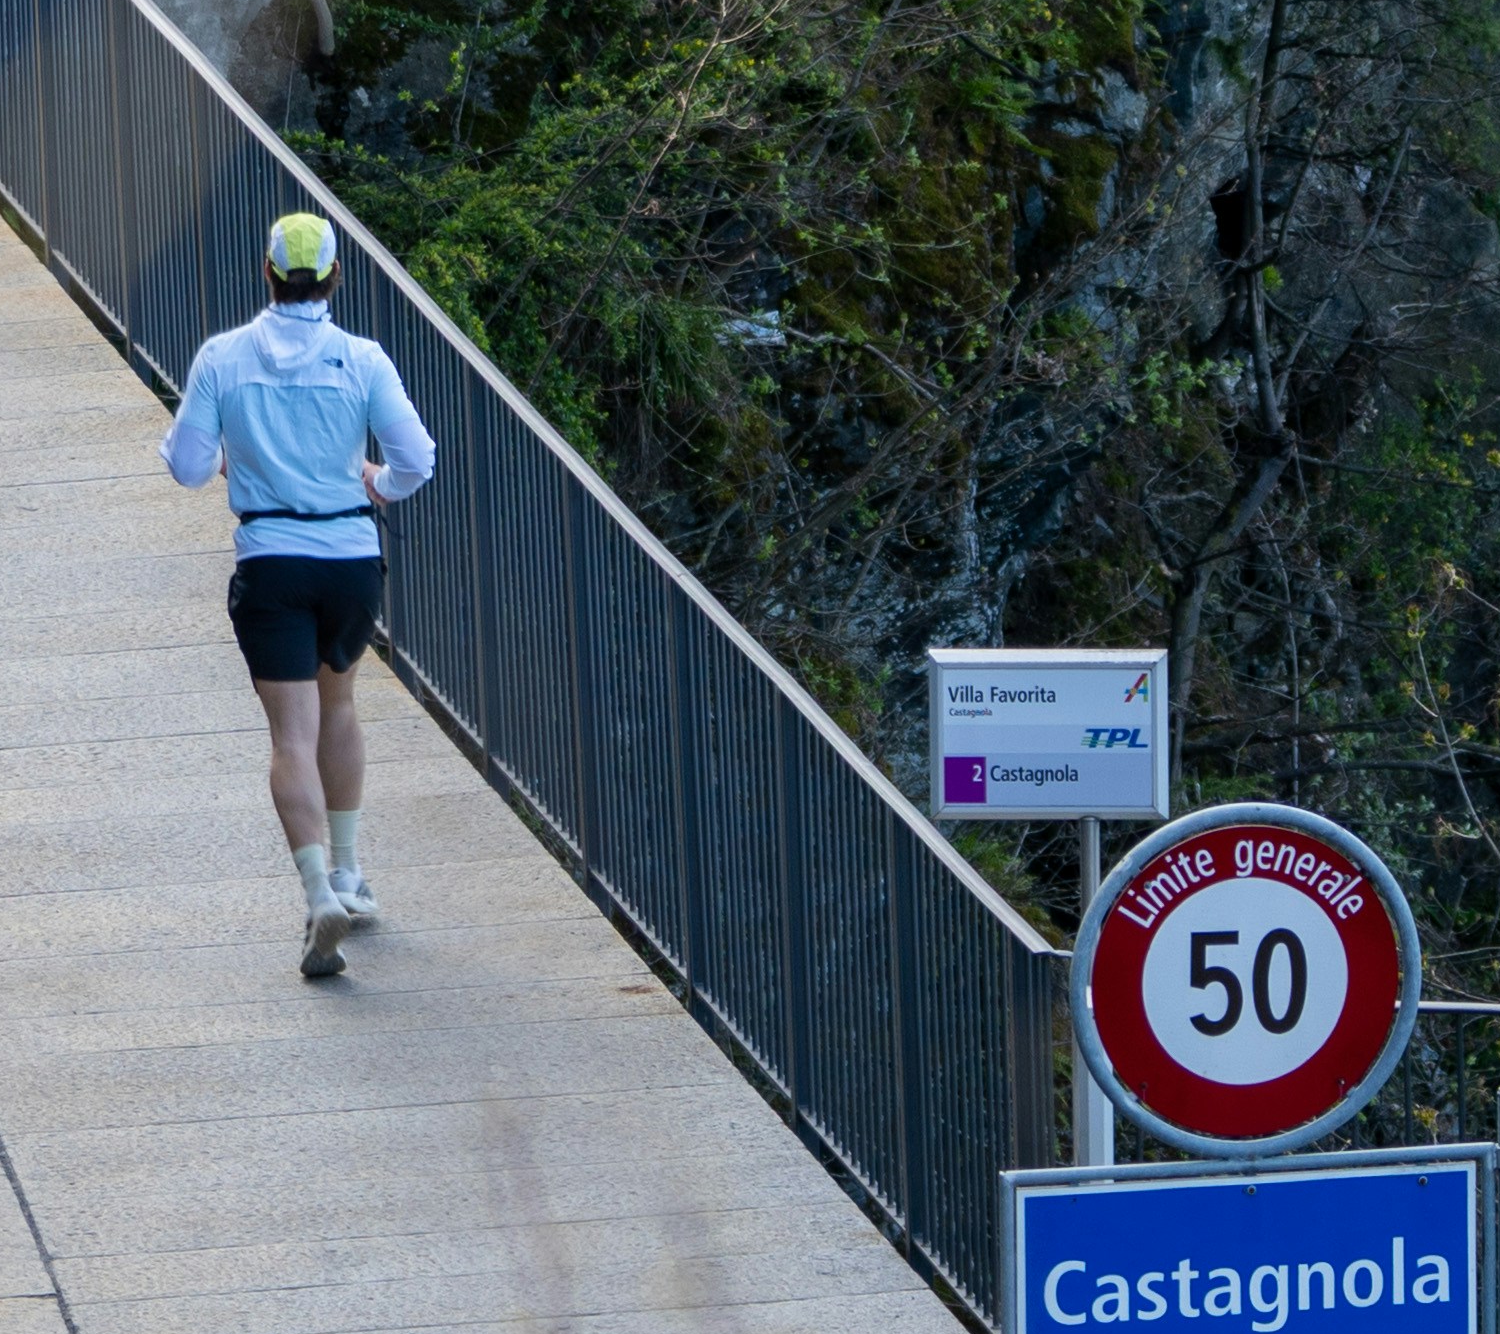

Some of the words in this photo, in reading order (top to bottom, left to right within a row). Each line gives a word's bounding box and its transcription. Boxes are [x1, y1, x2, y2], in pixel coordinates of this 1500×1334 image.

[948, 685, 984, 703] Villa
[990, 685, 1056, 703] Favorita
[949, 707, 993, 718] Castagnola
[1084, 728, 1148, 748] TPL
[972, 764, 982, 782] 2
[990, 764, 1079, 786] Castagnola
[1117, 847, 1216, 929] Limite
[1234, 838, 1364, 921] generale
[1189, 927, 1308, 1036] 50
[1043, 1236, 1451, 1333] Castagnola
